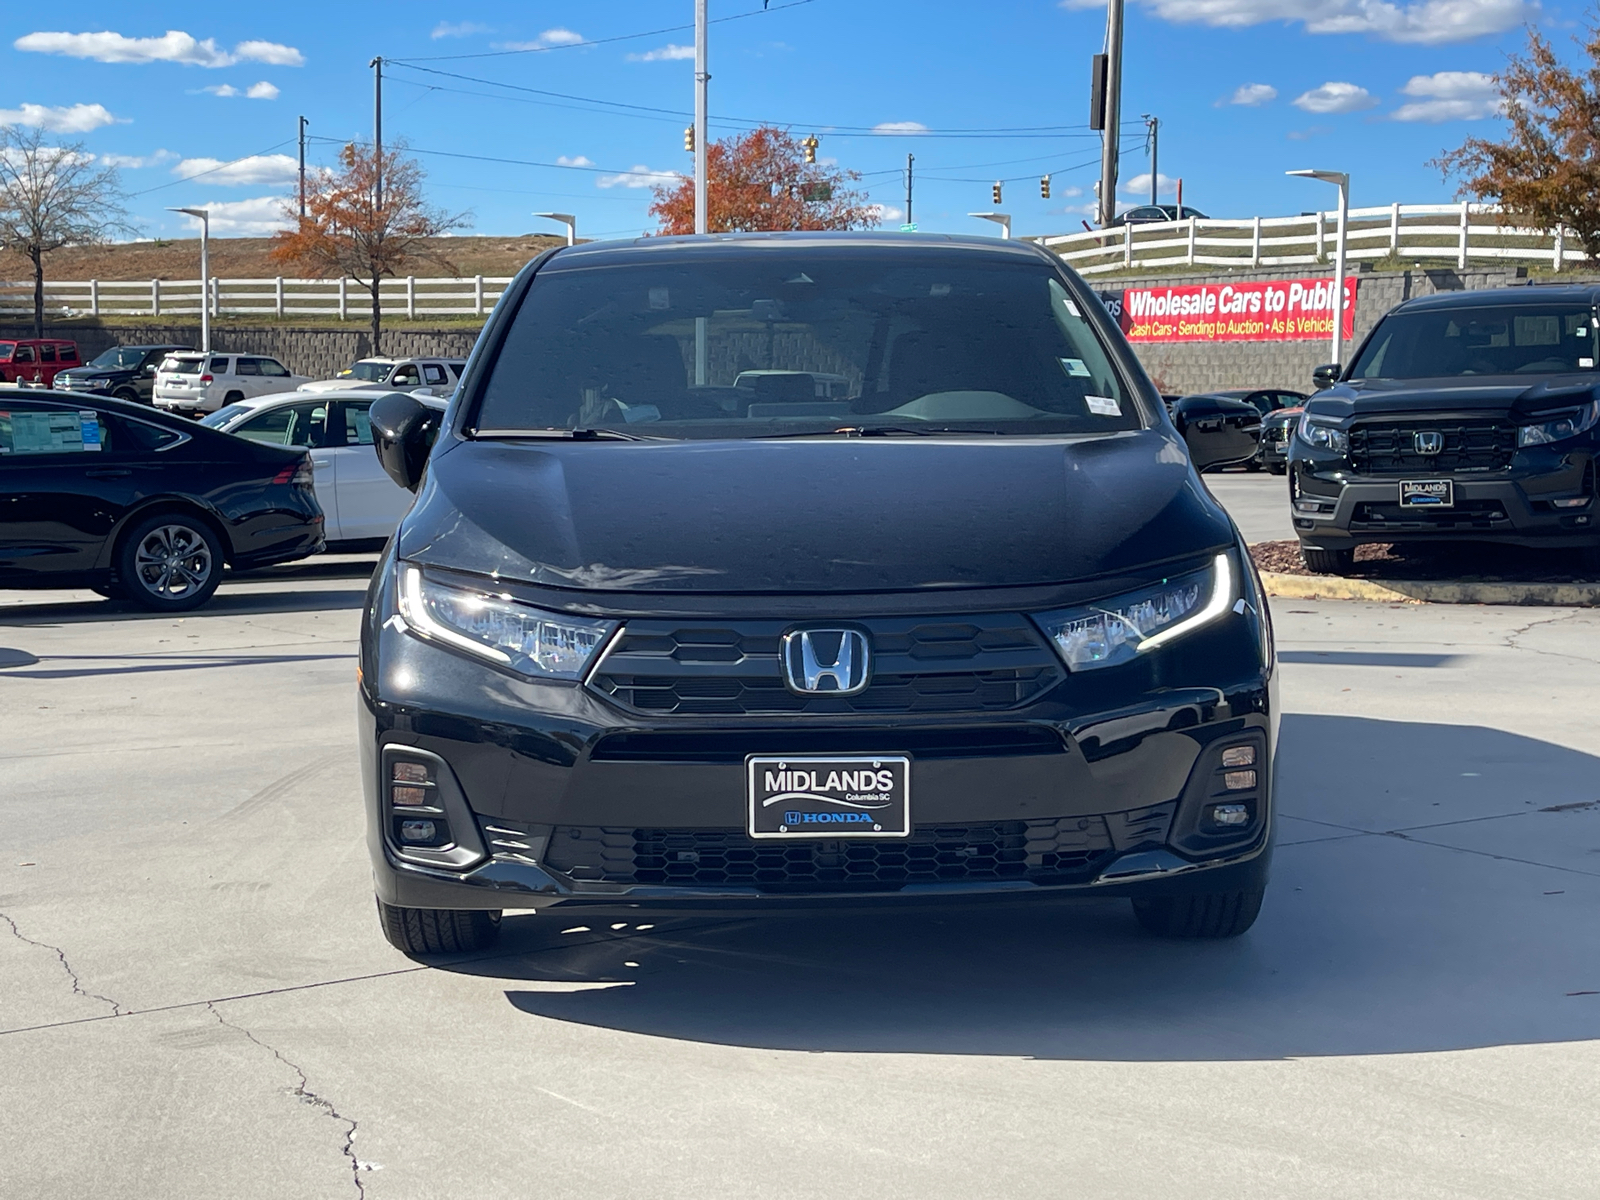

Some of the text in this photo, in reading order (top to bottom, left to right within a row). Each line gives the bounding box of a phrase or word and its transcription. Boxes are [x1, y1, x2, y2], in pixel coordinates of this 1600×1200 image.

[1129, 287, 1217, 317] Wholesale
[1218, 285, 1263, 315] Cars
[1264, 286, 1286, 312] to
[1129, 321, 1152, 336] Cash
[1151, 321, 1173, 336] Cars
[1178, 320, 1216, 339] Sending
[1216, 322, 1227, 335] to
[1227, 319, 1264, 335] Auction
[1270, 318, 1285, 334] As
[1285, 317, 1296, 333] Is
[1404, 483, 1447, 492] MIDLANDS
[764, 770, 894, 792] MIDLANDS
[845, 793, 891, 801] Columbia SC
[802, 813, 874, 823] HONDA
